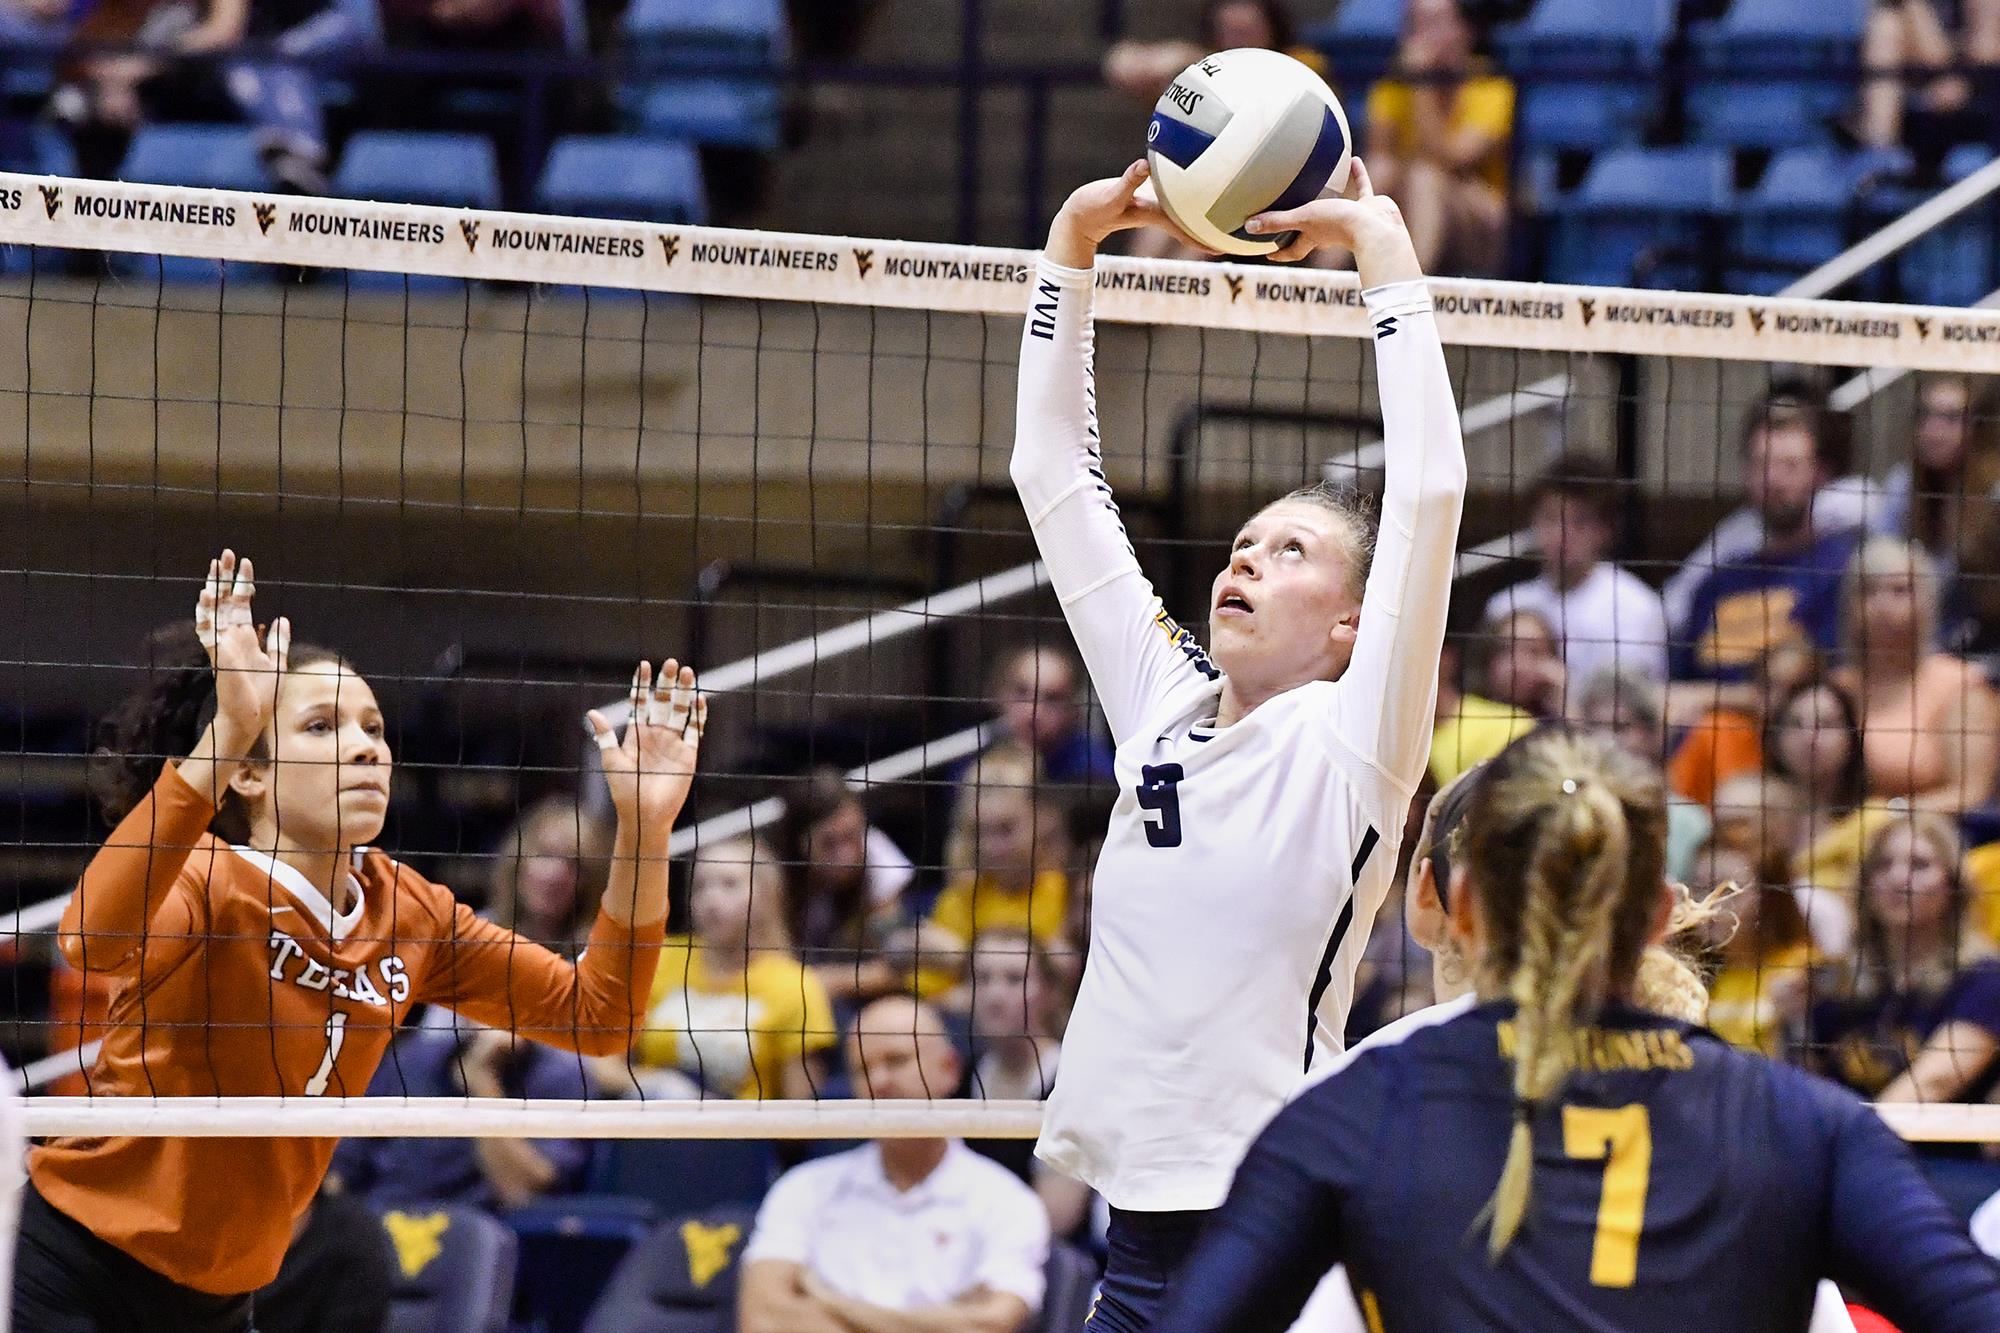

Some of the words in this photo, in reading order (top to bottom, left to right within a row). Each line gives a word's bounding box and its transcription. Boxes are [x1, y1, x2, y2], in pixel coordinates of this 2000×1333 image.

[74, 196, 236, 226] MOUNTAINEERS
[289, 212, 445, 243] MOUNTAINEERS
[492, 228, 645, 258] MOUNTAINEERS
[692, 244, 838, 271] MOUNTAINEERS
[885, 257, 1028, 283] MOUNTAINEERS
[1434, 295, 1564, 320] MOUNTAINEERS
[1607, 305, 1735, 329] MOUNTAINEERS
[1776, 315, 1900, 339] MOUNTAINEERS
[1136, 763, 1185, 848] 9
[269, 930, 411, 1006] TEXAS
[304, 1012, 349, 1097] 1
[1562, 1103, 1653, 1288] 7
